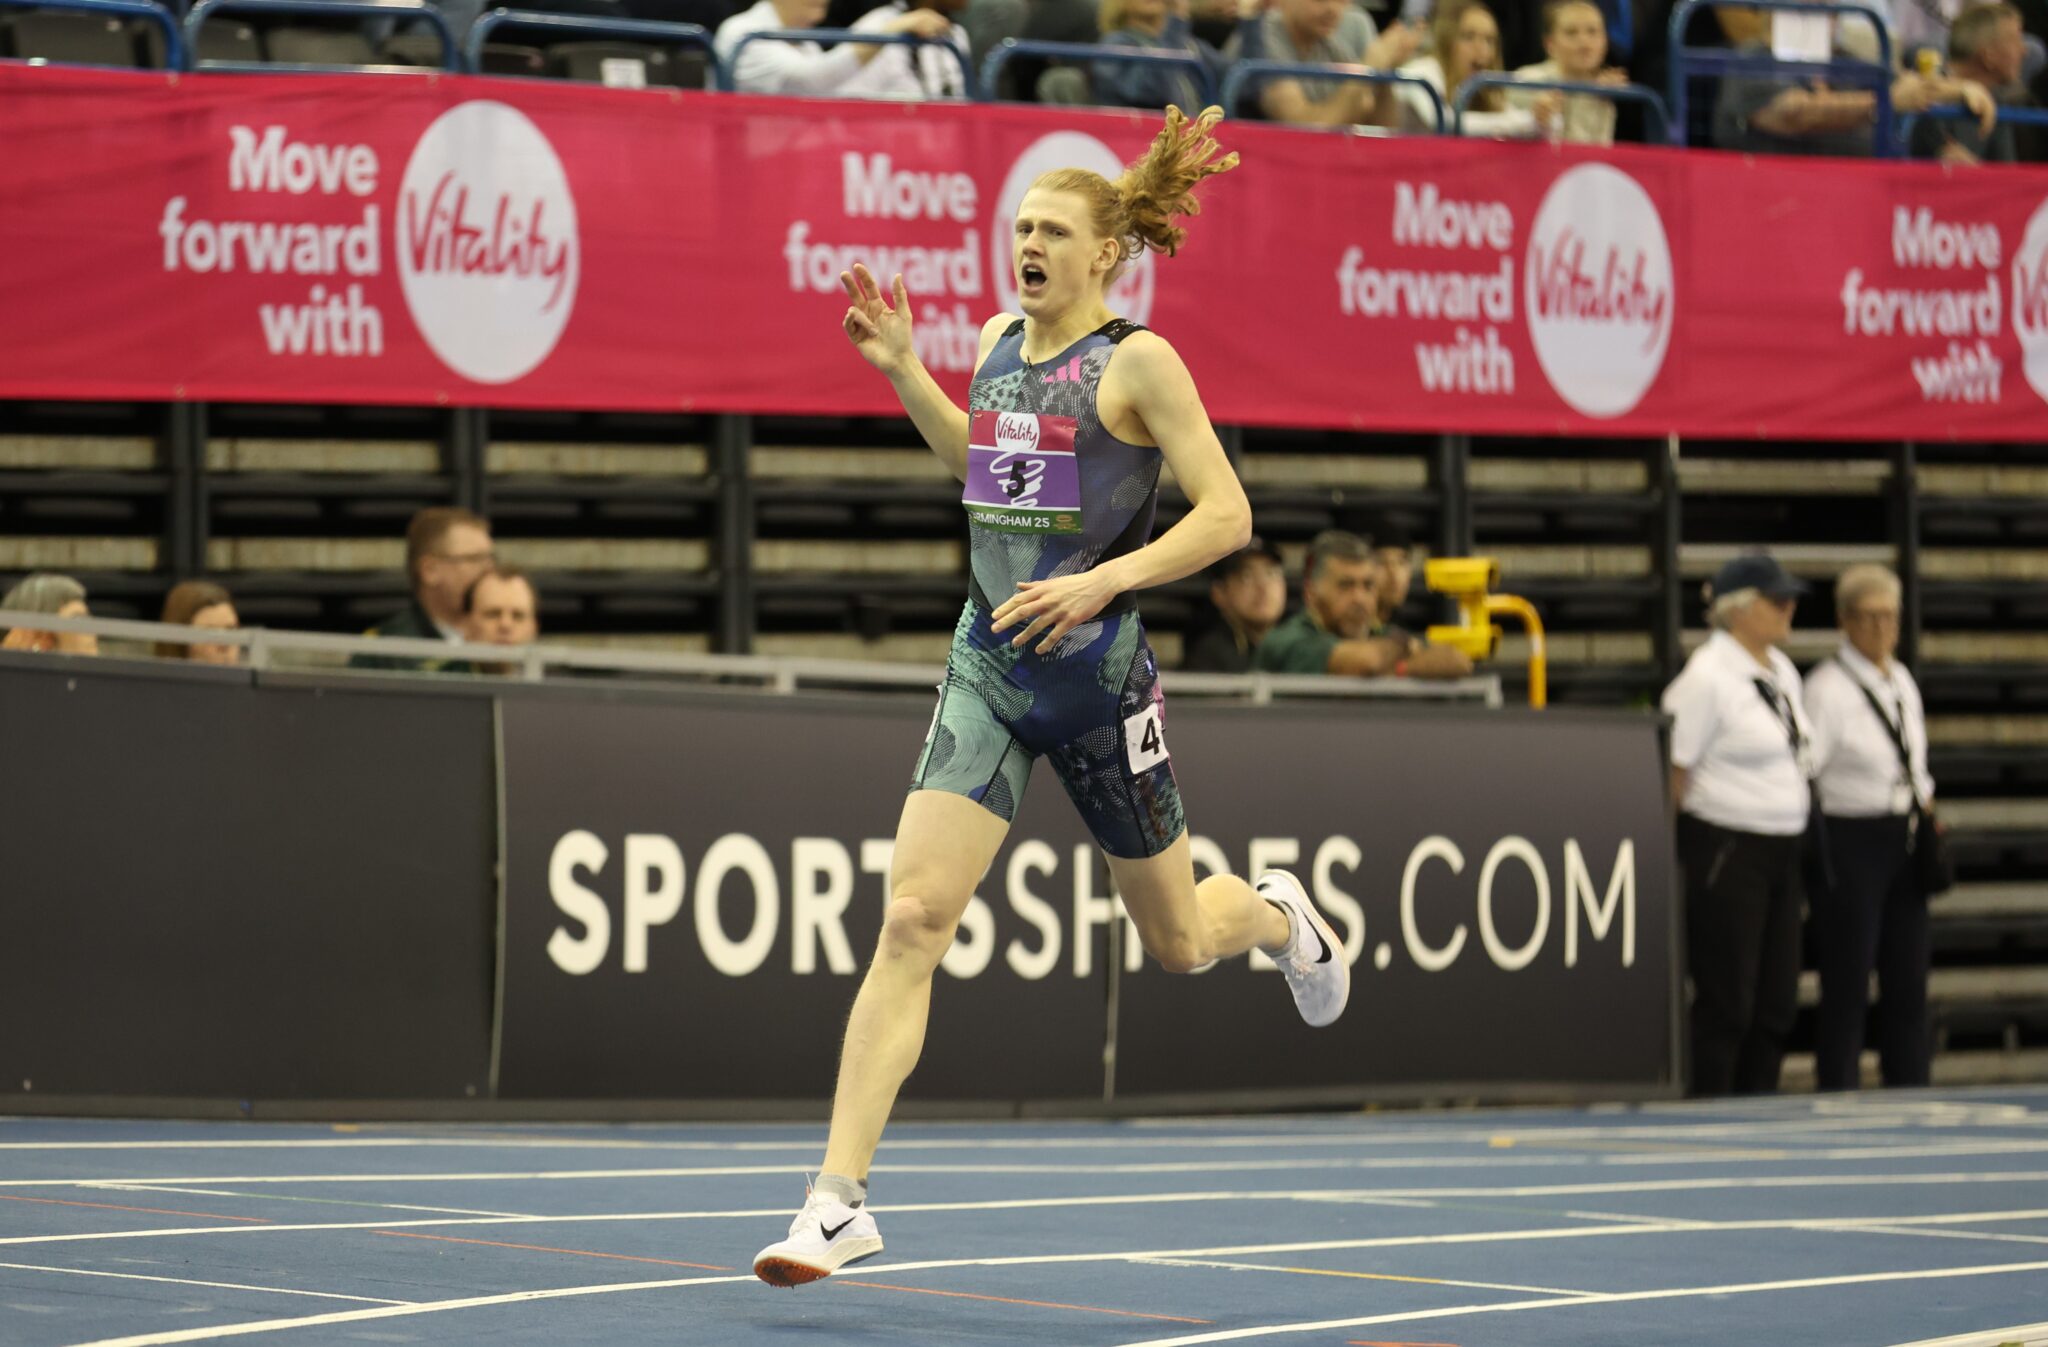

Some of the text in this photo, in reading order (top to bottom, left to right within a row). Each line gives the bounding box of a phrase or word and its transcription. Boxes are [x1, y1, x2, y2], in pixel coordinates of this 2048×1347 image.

[228, 125, 379, 196] Move
[841, 151, 979, 223] Move
[159, 197, 381, 276] forward
[403, 168, 574, 316] Vitality
[1392, 181, 1514, 251] Move
[1892, 205, 2002, 271] Move
[784, 220, 982, 298] forward
[1336, 246, 1515, 323] forward
[1532, 227, 1667, 358] Vitality
[258, 284, 384, 357] with
[1842, 266, 2002, 337] forward
[911, 301, 982, 374] ith
[1414, 325, 1515, 394] with
[1911, 338, 2003, 404] with
[997, 415, 1038, 450] Vitality
[1006, 460, 1027, 498] 5
[969, 510, 1032, 528] RMINGHAM
[1034, 516, 1051, 529] 25
[1140, 715, 1162, 756] 4
